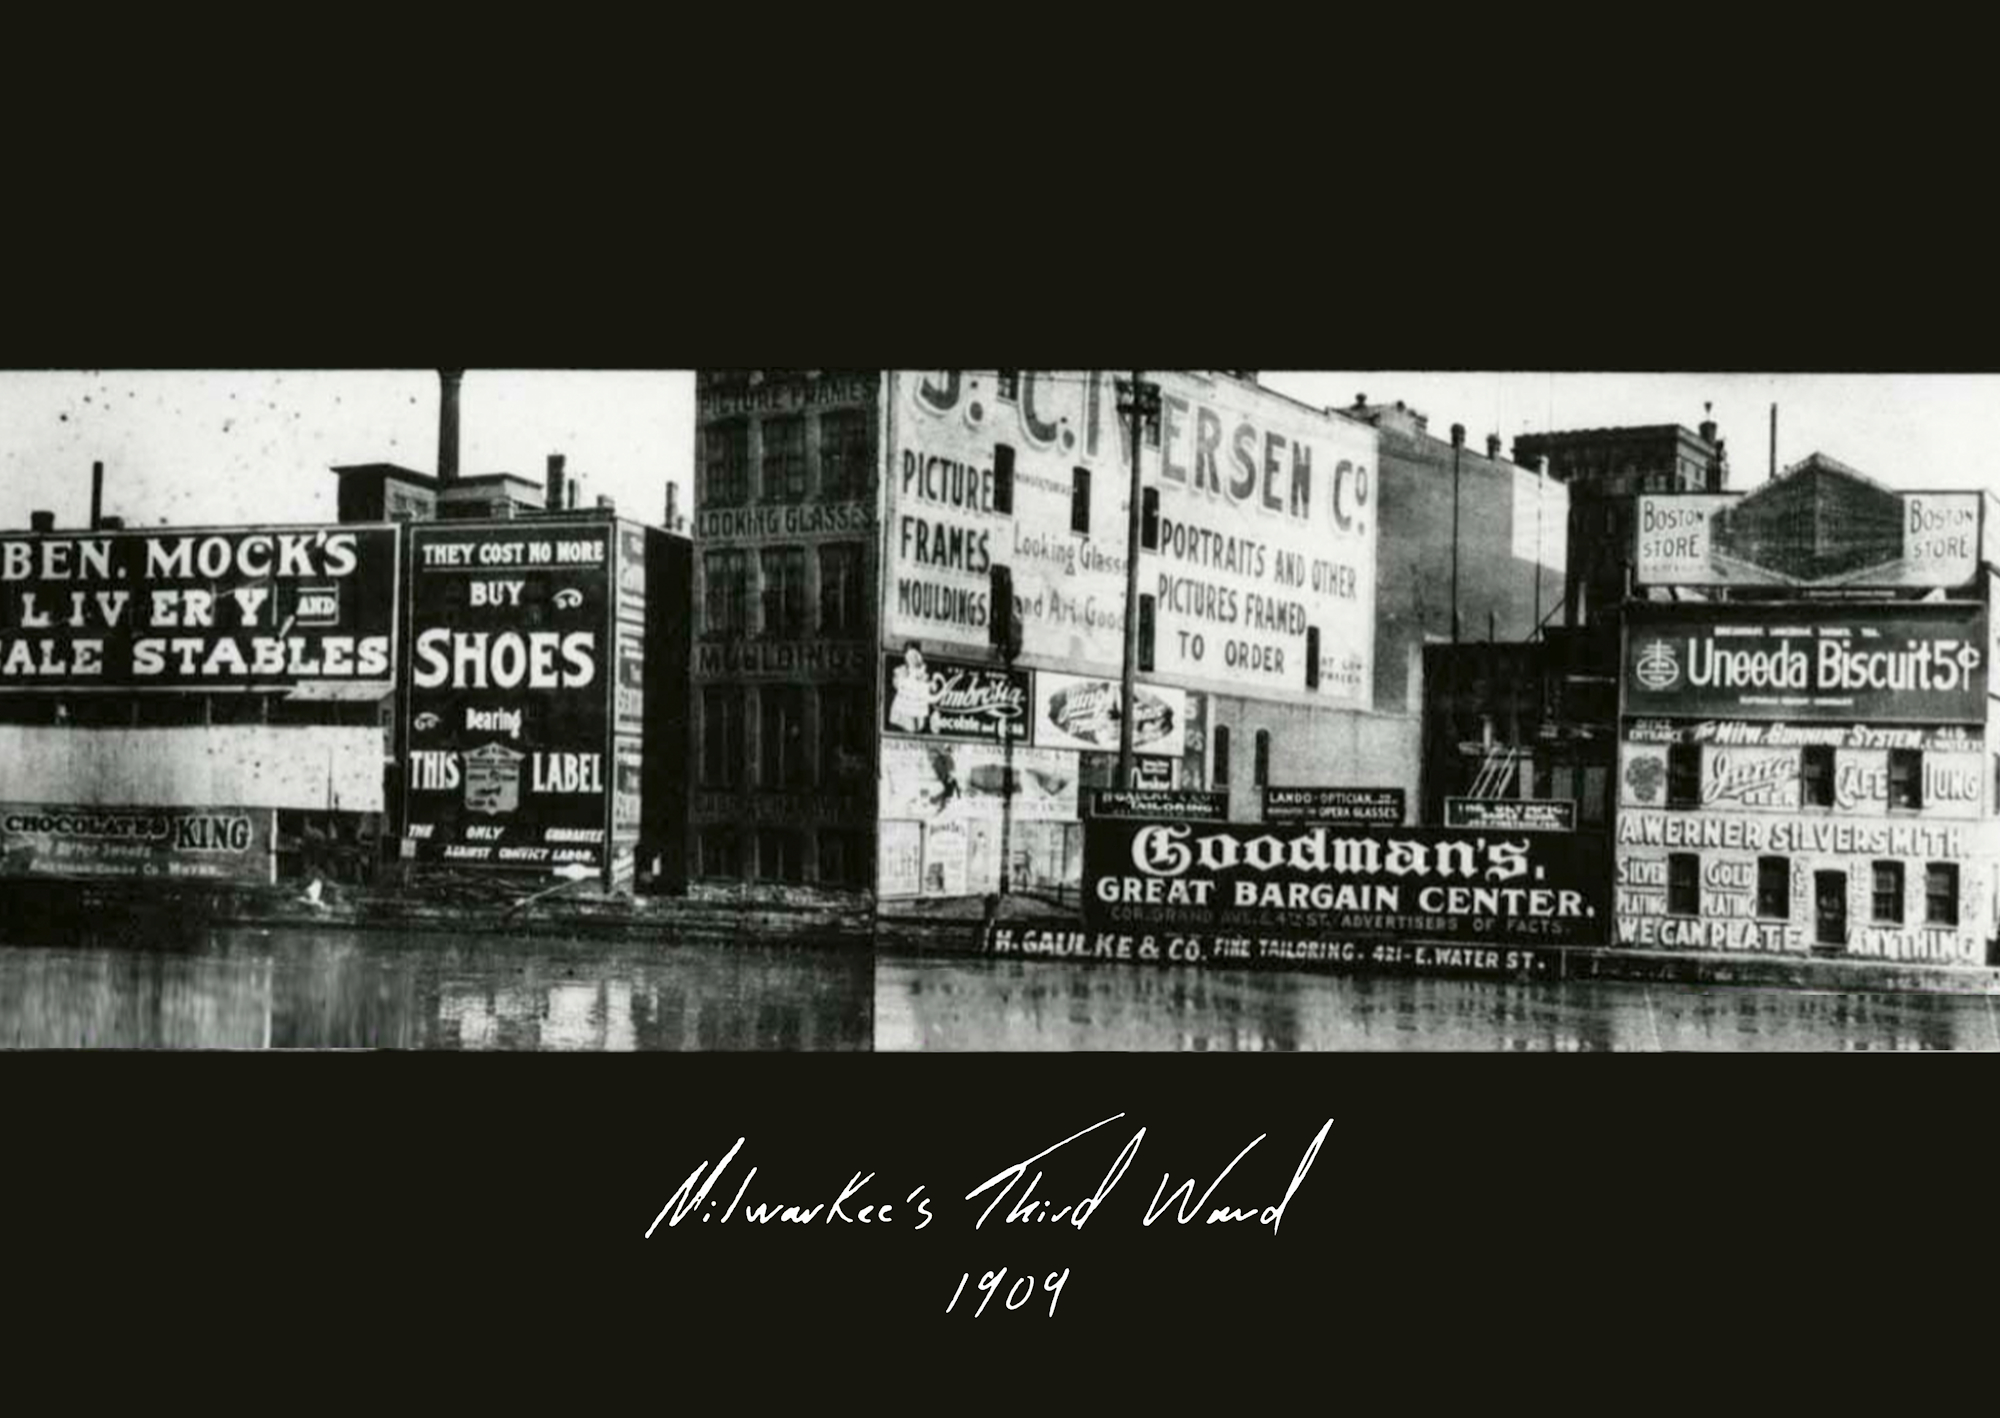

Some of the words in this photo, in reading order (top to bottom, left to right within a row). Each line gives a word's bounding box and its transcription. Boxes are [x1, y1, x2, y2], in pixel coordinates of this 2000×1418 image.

[902, 449, 993, 514] PICTURE
[699, 508, 778, 537] LOOKING
[785, 505, 873, 535] GLASSES
[2, 539, 127, 580] BEN.
[145, 531, 359, 579] MOCK'S
[422, 543, 476, 566] THEY
[479, 543, 525, 564] COST
[528, 542, 553, 563] NO
[556, 541, 605, 562] MORE
[901, 516, 991, 575] FRAMES
[1161, 518, 1267, 578] PORTRAITS
[1274, 549, 1306, 588] AND
[1312, 559, 1357, 599] OTHER
[298, 595, 336, 616] AND
[469, 581, 525, 606] BUY
[898, 578, 988, 627] MOULDINGS
[1159, 573, 1239, 623] PICTURES
[1245, 593, 1307, 637] FRAMED
[0, 637, 104, 675] ALE
[132, 636, 389, 675] STABLES
[413, 627, 597, 689] SHOES
[1177, 629, 1206, 662] TO
[1225, 639, 1285, 675] ORDER
[1687, 637, 1808, 688] Uneeda
[1817, 639, 1931, 690] Biscuit
[1932, 639, 1981, 692] 5¢
[466, 707, 522, 738] Bearing
[409, 751, 460, 790] THIS
[532, 753, 604, 794] LABEL
[3, 813, 170, 839] CHOCOLATES
[175, 815, 253, 852] KING
[408, 825, 434, 839] THE
[466, 826, 505, 840] ONLY
[1131, 822, 1545, 882] Goodman's.
[498, 846, 549, 861] CONVICT
[1704, 859, 1754, 889] GOLD
[1097, 876, 1216, 905] GREAT
[1234, 880, 1399, 912] BARGAIN
[1418, 885, 1596, 918] CENTER.
[1340, 914, 1459, 932] ADVERTISERS
[1472, 916, 1495, 932] OF
[1615, 915, 1655, 946] WE
[1660, 918, 1703, 947] CAN
[1710, 919, 1805, 952] PLATE
[1138, 935, 1160, 960] &
[1168, 937, 1208, 961] CO.
[1214, 937, 1251, 959] FINE
[1506, 951, 1545, 970] ST.
